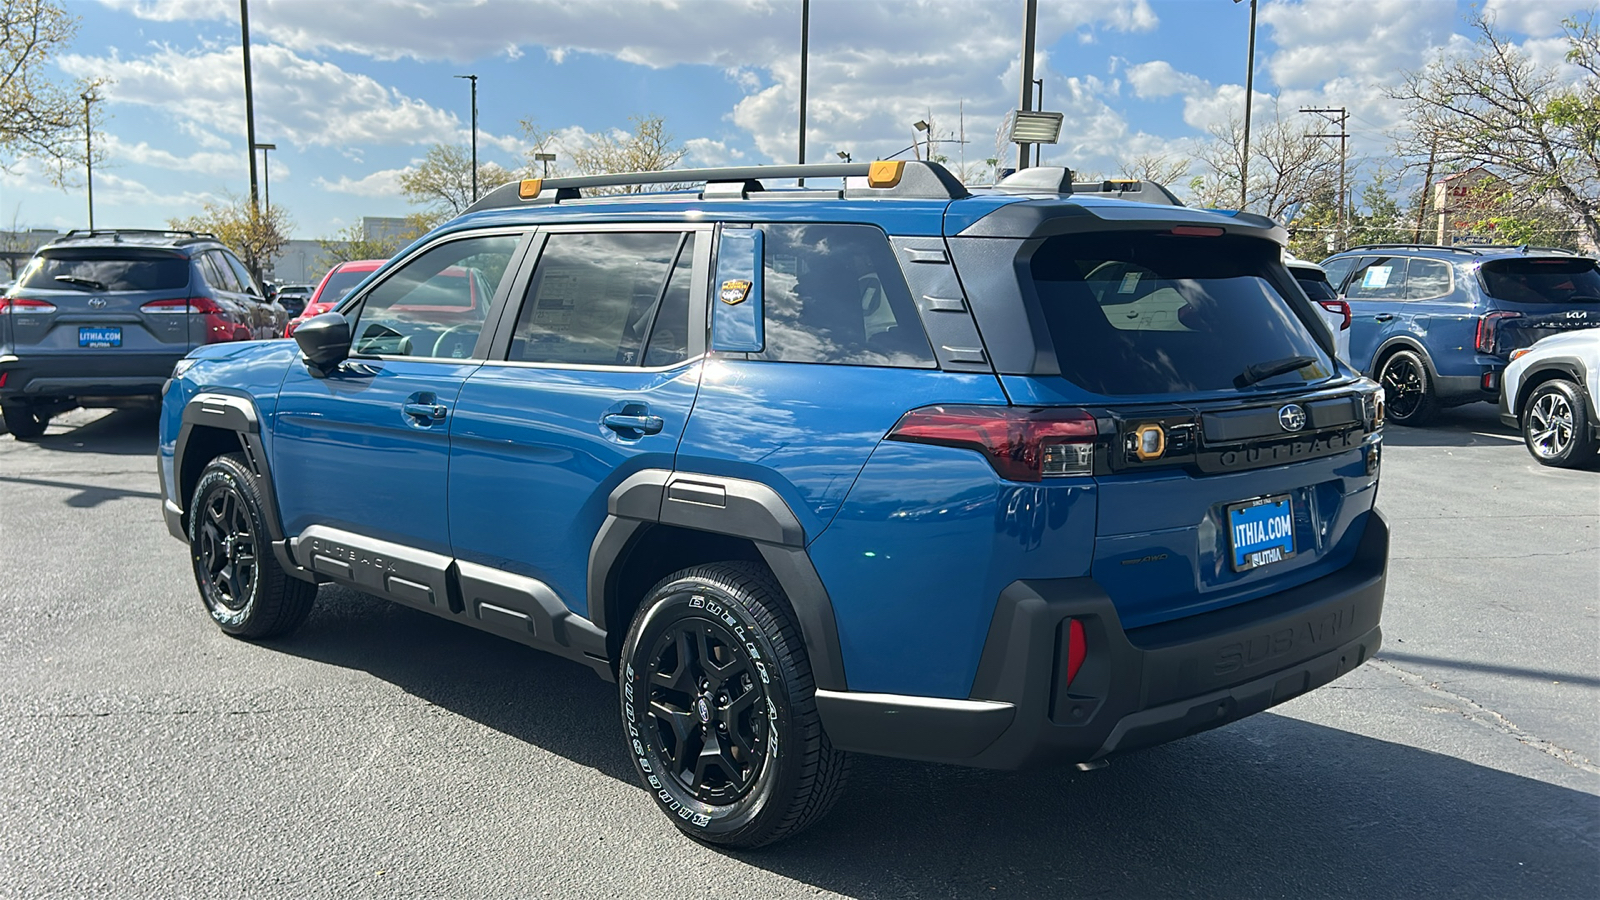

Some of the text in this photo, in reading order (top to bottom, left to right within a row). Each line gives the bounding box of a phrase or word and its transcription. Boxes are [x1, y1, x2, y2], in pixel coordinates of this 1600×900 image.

[79, 332, 121, 341] LITHIA.COM
[1220, 429, 1351, 466] OUTBACK
[1234, 514, 1292, 549] ITHIA.COM
[312, 540, 397, 572] OUTBACK
[1259, 547, 1282, 566] LITHIA
[689, 595, 770, 684] DUELER
[1213, 604, 1356, 677] SUBARU
[621, 662, 712, 828] BRIDGESTONE
